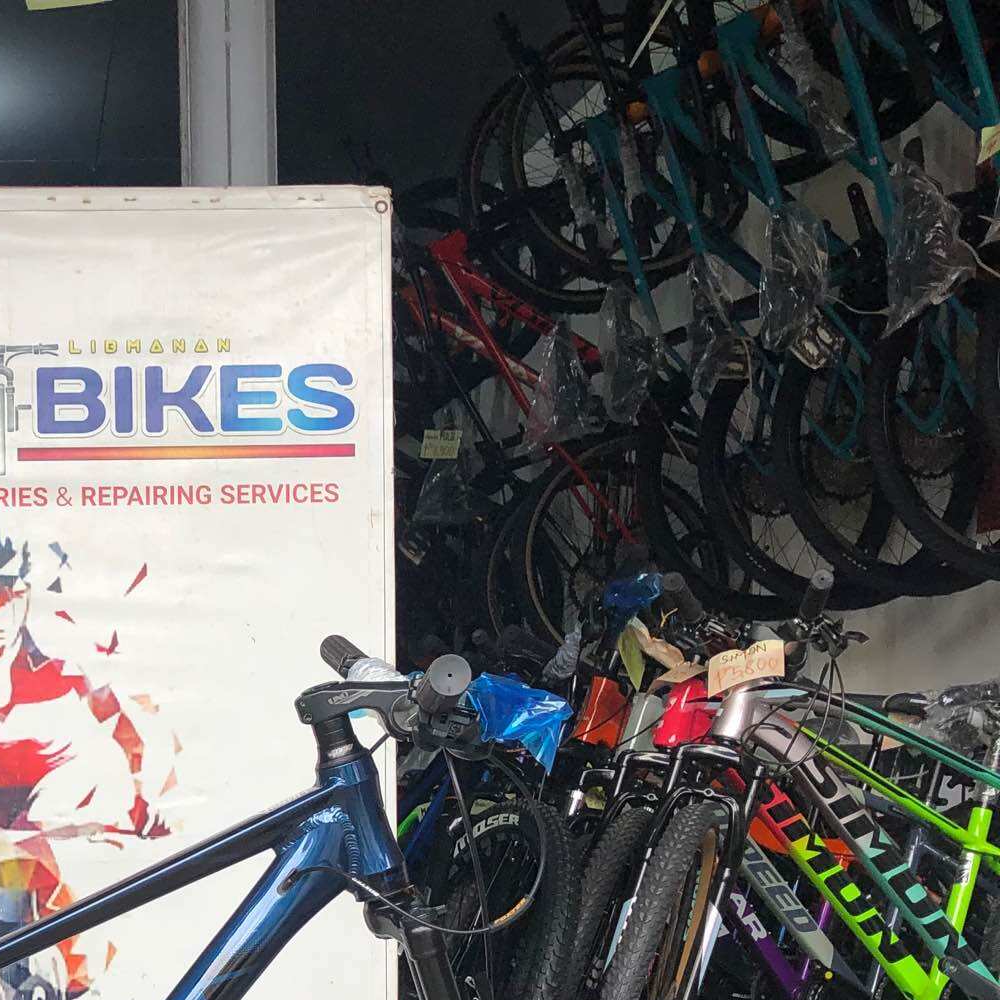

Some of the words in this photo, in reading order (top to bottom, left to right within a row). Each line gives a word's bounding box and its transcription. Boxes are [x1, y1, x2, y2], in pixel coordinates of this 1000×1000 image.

[35, 362, 357, 435] BIKES
[55, 486, 73, 507] &
[80, 484, 212, 507] REPAIRING
[220, 482, 340, 505] SERVICES
[453, 813, 520, 859] MOSER
